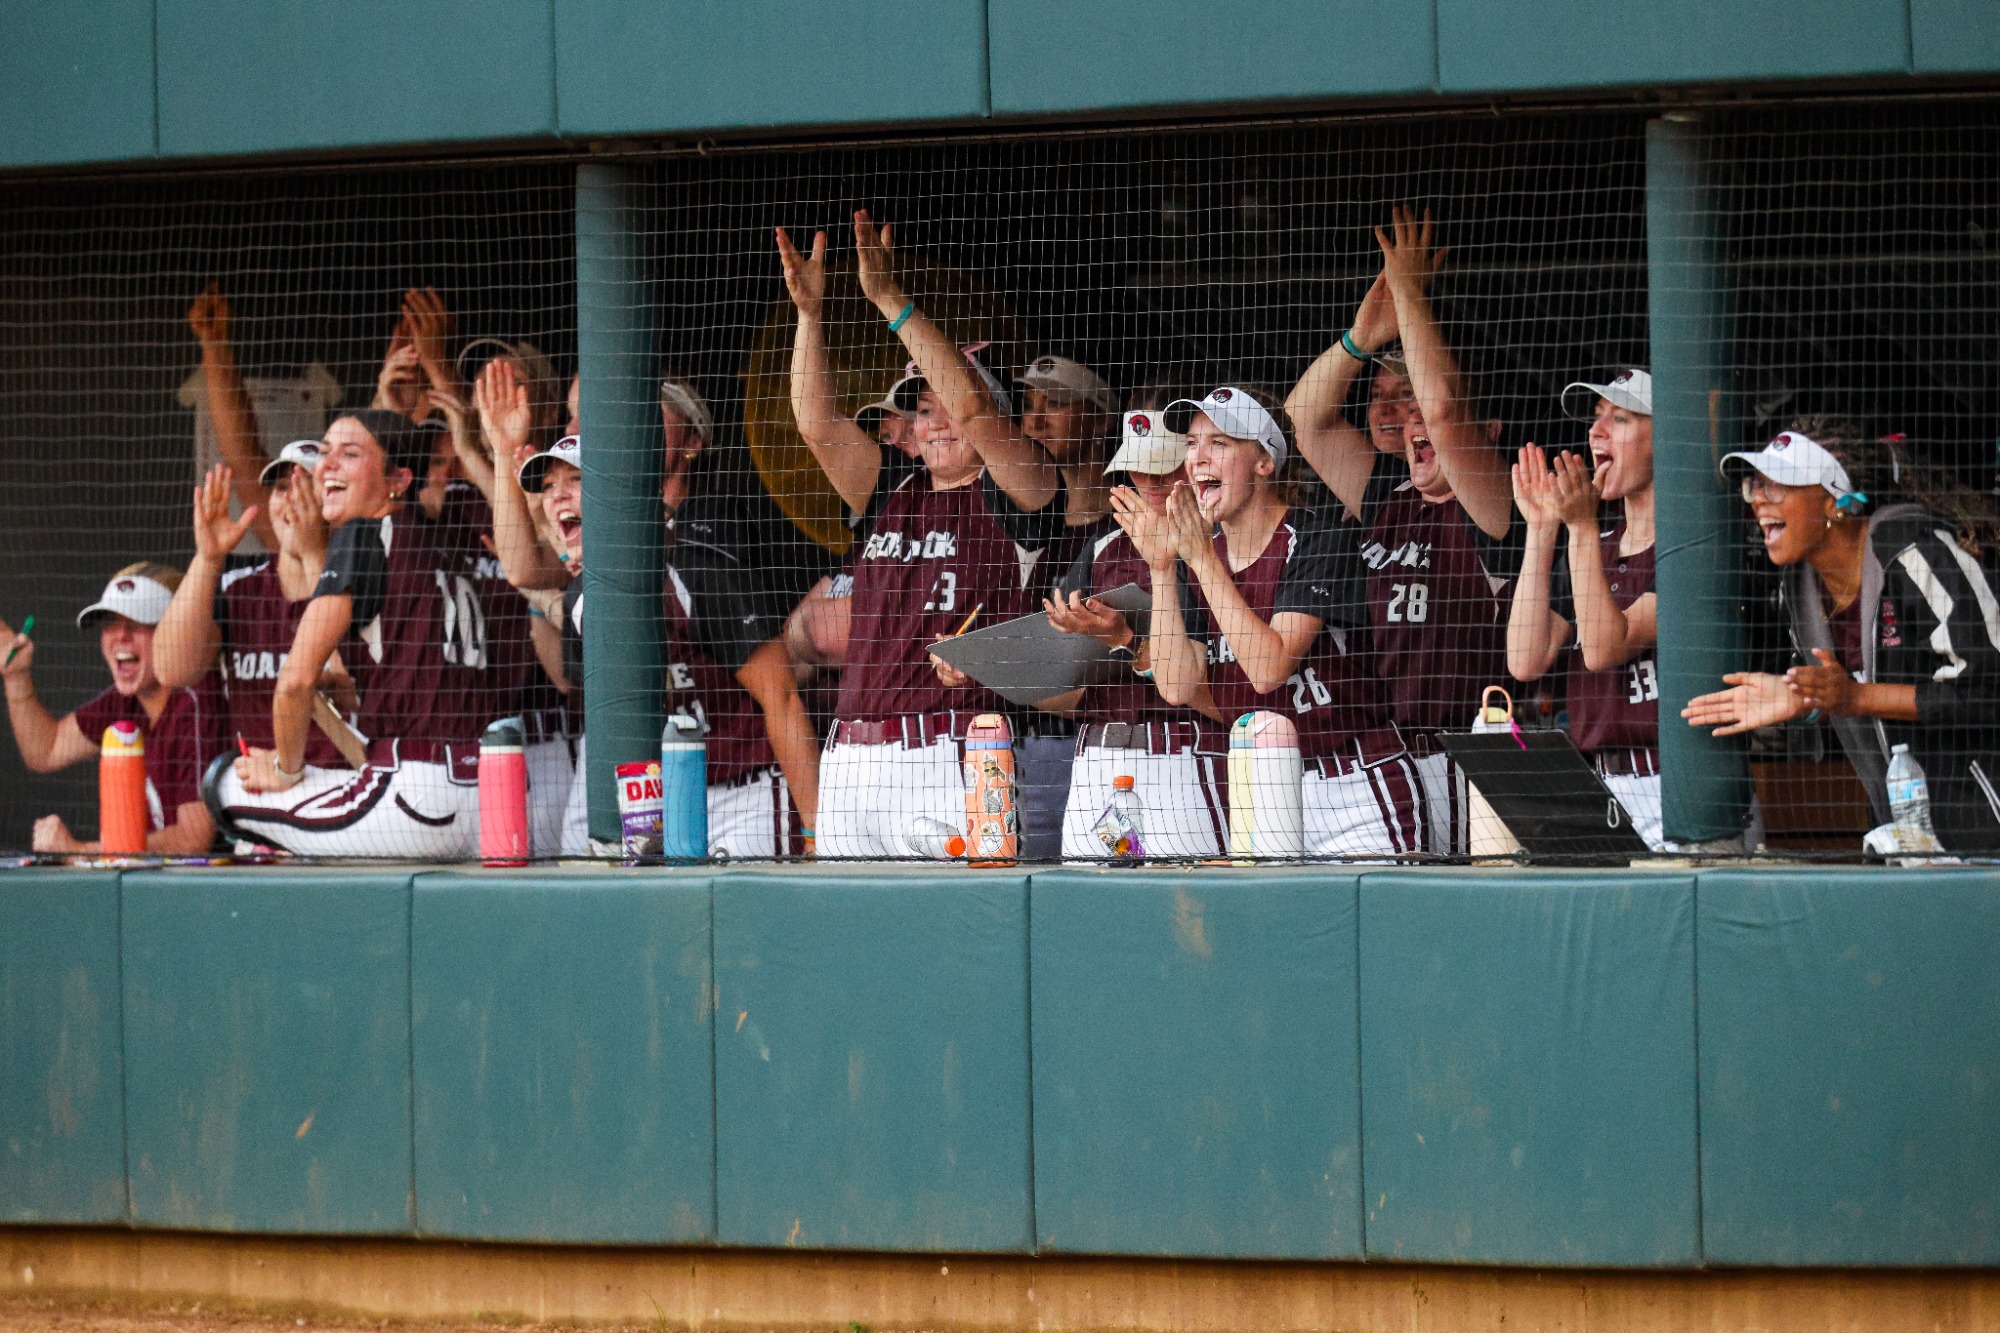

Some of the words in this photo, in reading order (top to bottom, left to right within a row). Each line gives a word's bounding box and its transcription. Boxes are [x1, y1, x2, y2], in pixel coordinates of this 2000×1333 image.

[435, 568, 487, 670] 10
[1387, 583, 1429, 623] 28
[1286, 667, 1333, 714] 26
[1629, 660, 1659, 704] 33
